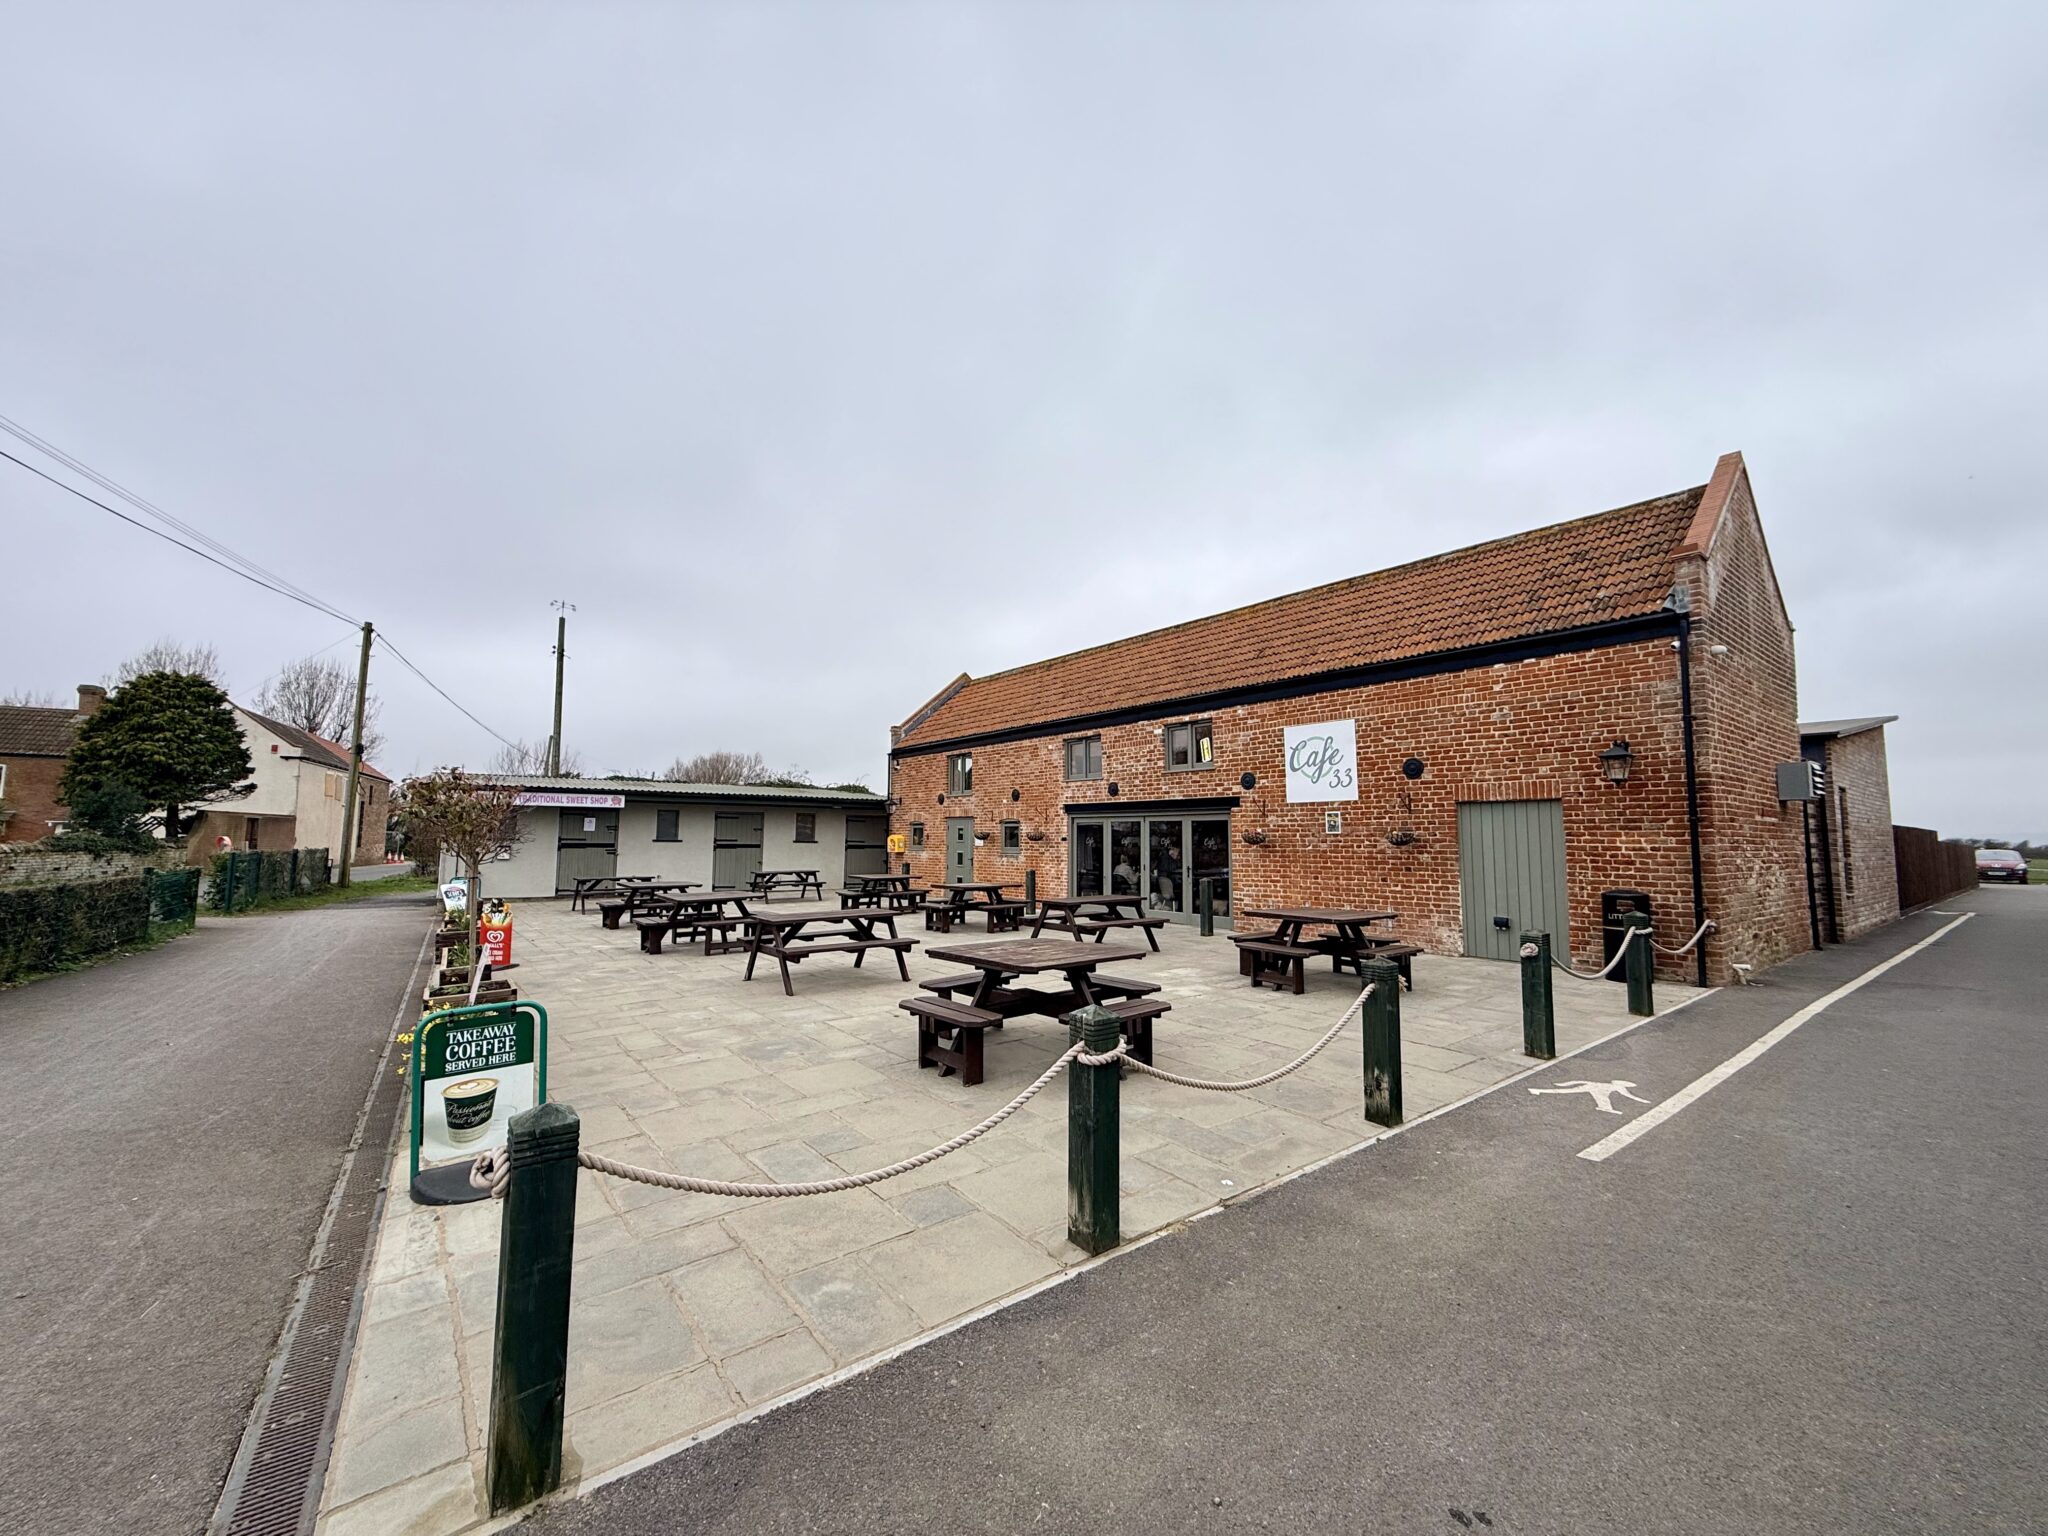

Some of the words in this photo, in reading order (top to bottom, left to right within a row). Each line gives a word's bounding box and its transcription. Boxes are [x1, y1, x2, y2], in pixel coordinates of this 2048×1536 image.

[1289, 736, 1344, 784] Cafe
[1329, 768, 1352, 788] 33
[518, 794, 564, 804] TRADITIONAL
[566, 796, 588, 805] SWEET
[590, 797, 608, 805] SHOP
[446, 1024, 516, 1045] TAKEAWAY
[445, 1036, 516, 1061] COFFEE
[445, 1058, 486, 1072] SERVED
[488, 1052, 516, 1066] HERE
